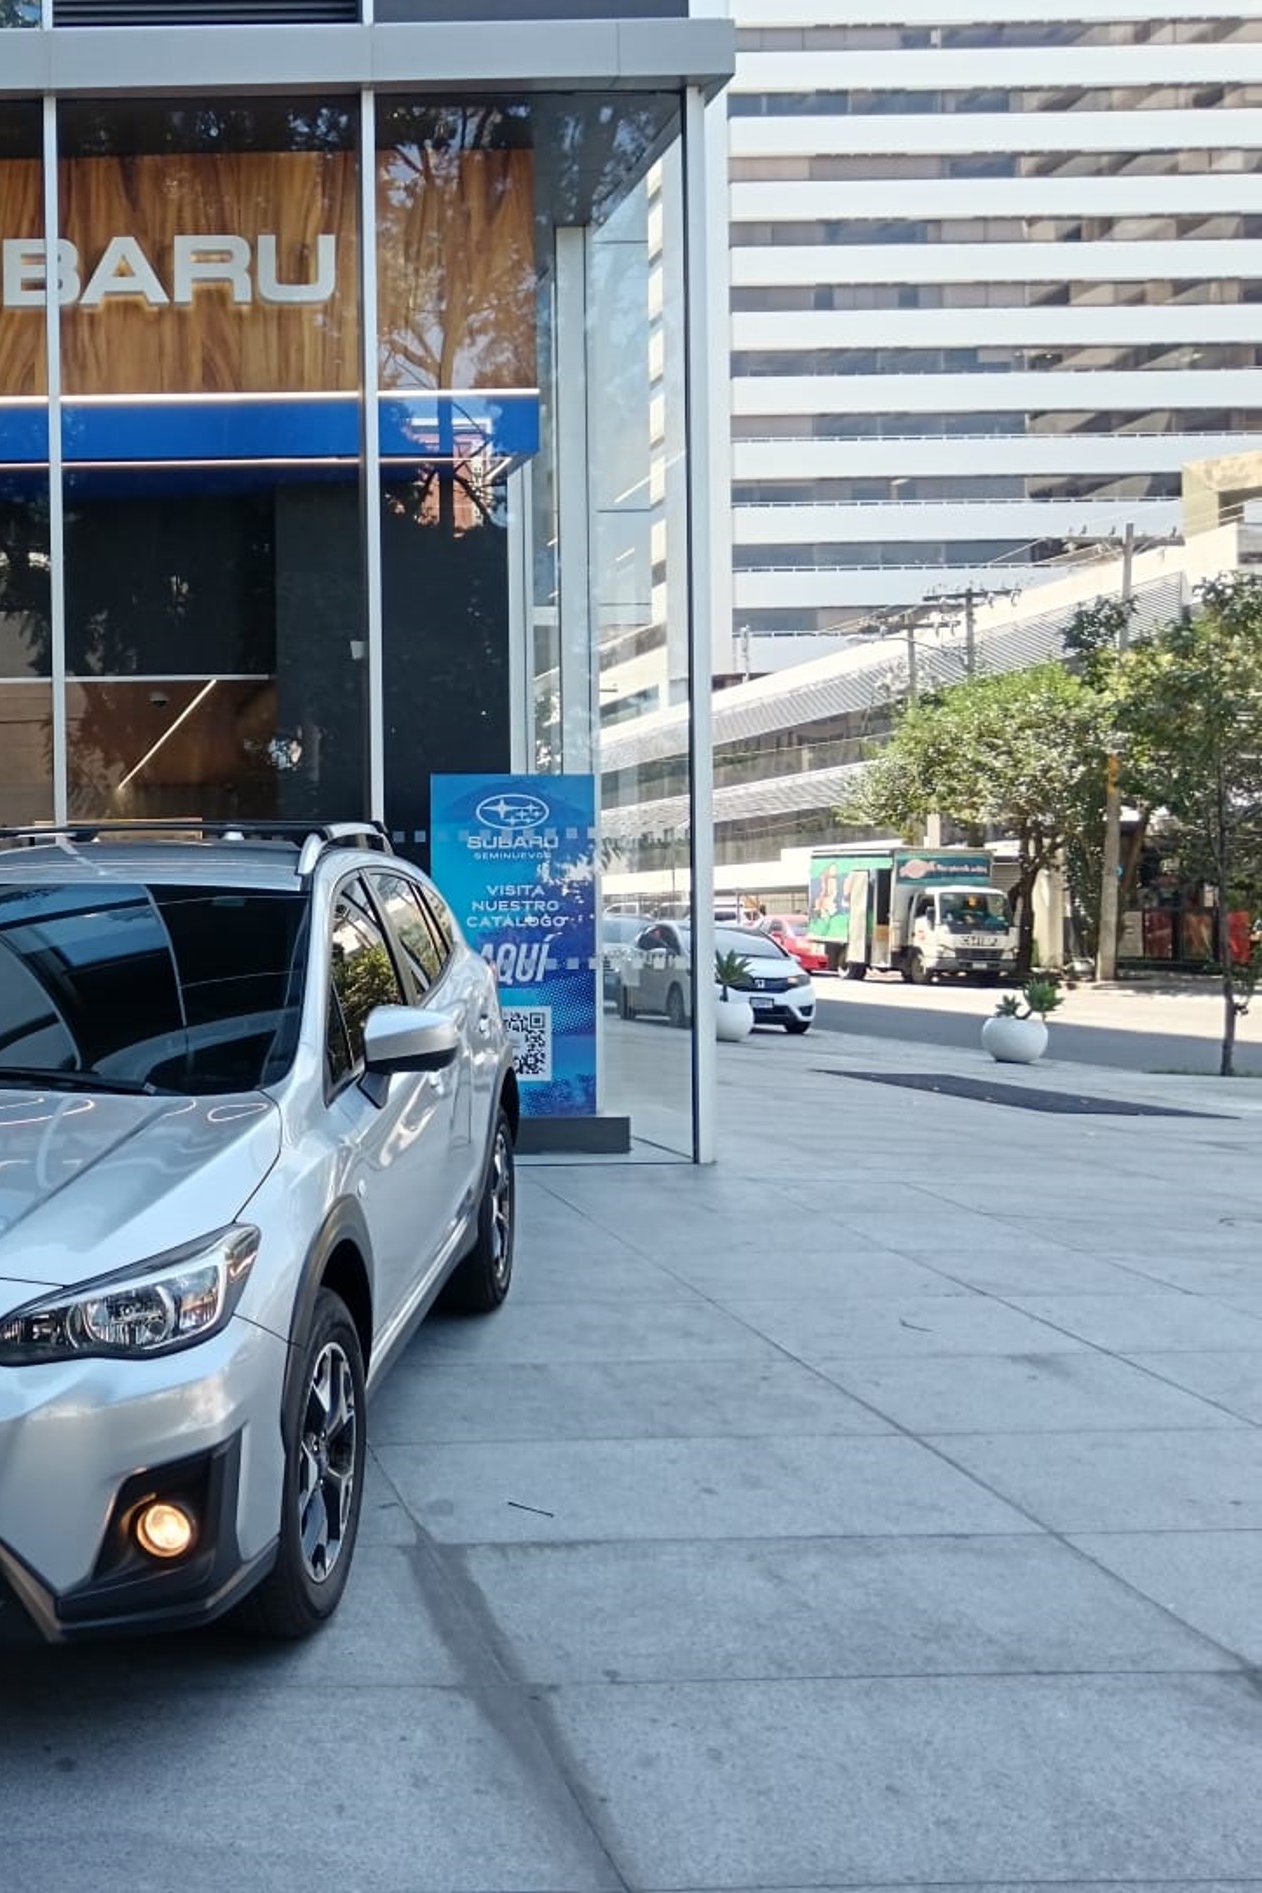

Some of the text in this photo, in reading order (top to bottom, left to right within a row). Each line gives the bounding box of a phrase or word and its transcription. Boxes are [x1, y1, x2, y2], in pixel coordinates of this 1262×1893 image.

[466, 835, 559, 850] SUBARU
[473, 851, 552, 861] SEMINUEVOS
[485, 884, 546, 898] VISITA
[471, 899, 560, 912] NUESTRO
